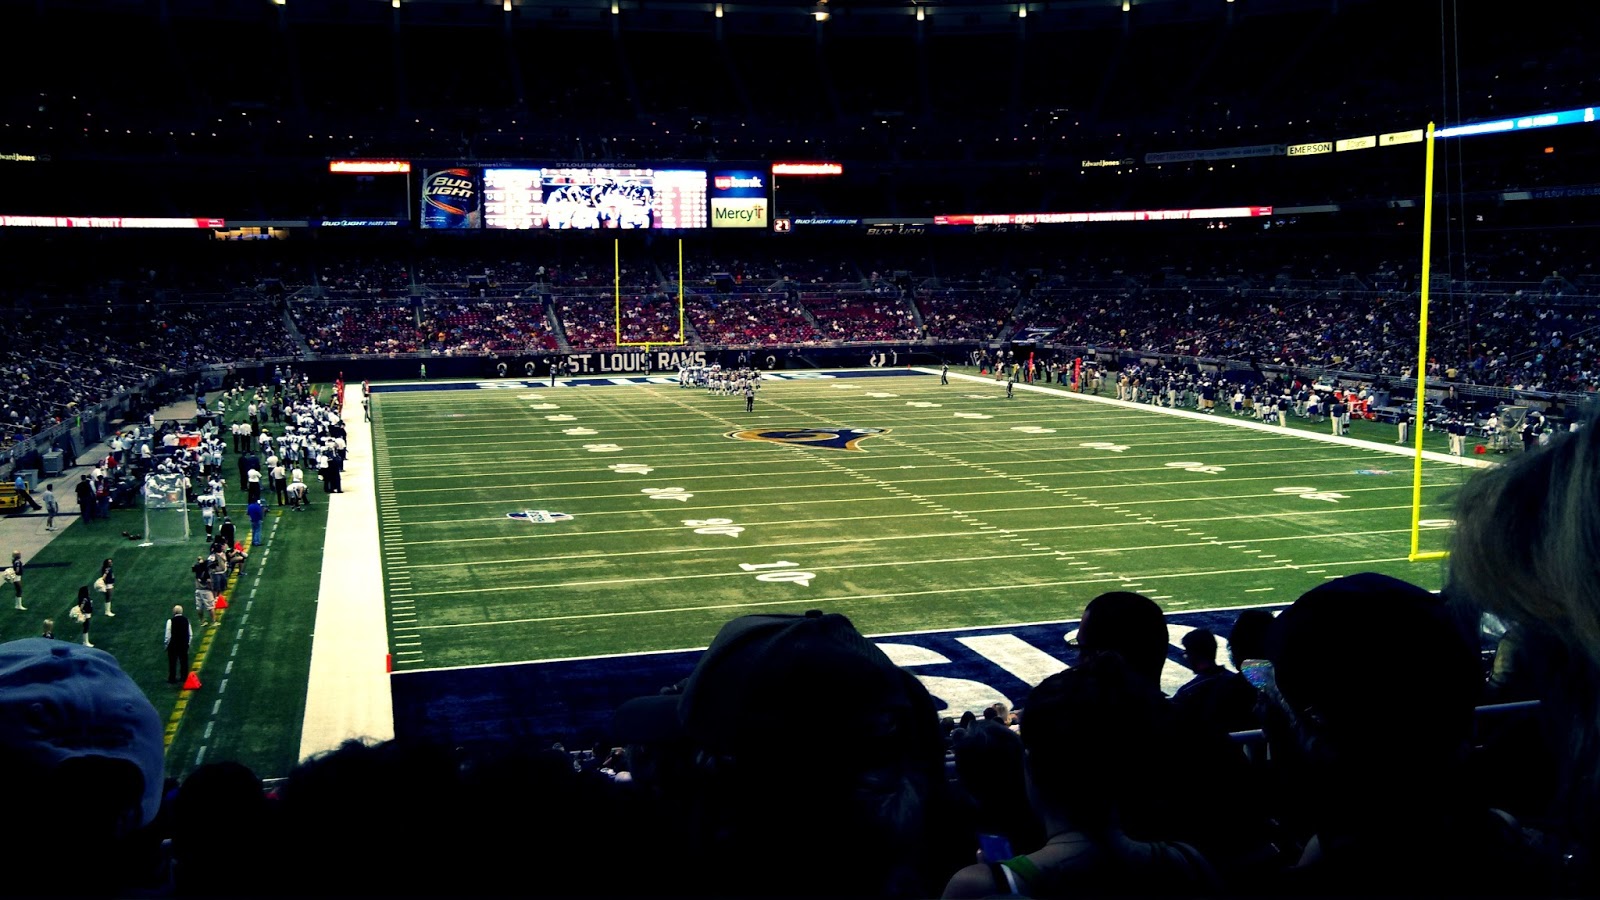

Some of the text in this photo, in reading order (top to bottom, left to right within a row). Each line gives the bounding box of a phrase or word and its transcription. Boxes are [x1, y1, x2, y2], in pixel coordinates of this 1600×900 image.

[1290, 143, 1331, 155] EMERSON
[433, 176, 473, 189] BUD
[425, 186, 474, 198] LIGHT
[715, 207, 754, 222] Mercy
[600, 352, 653, 372] LOUIS
[658, 350, 707, 370] RAMS
[738, 560, 817, 585] 10
